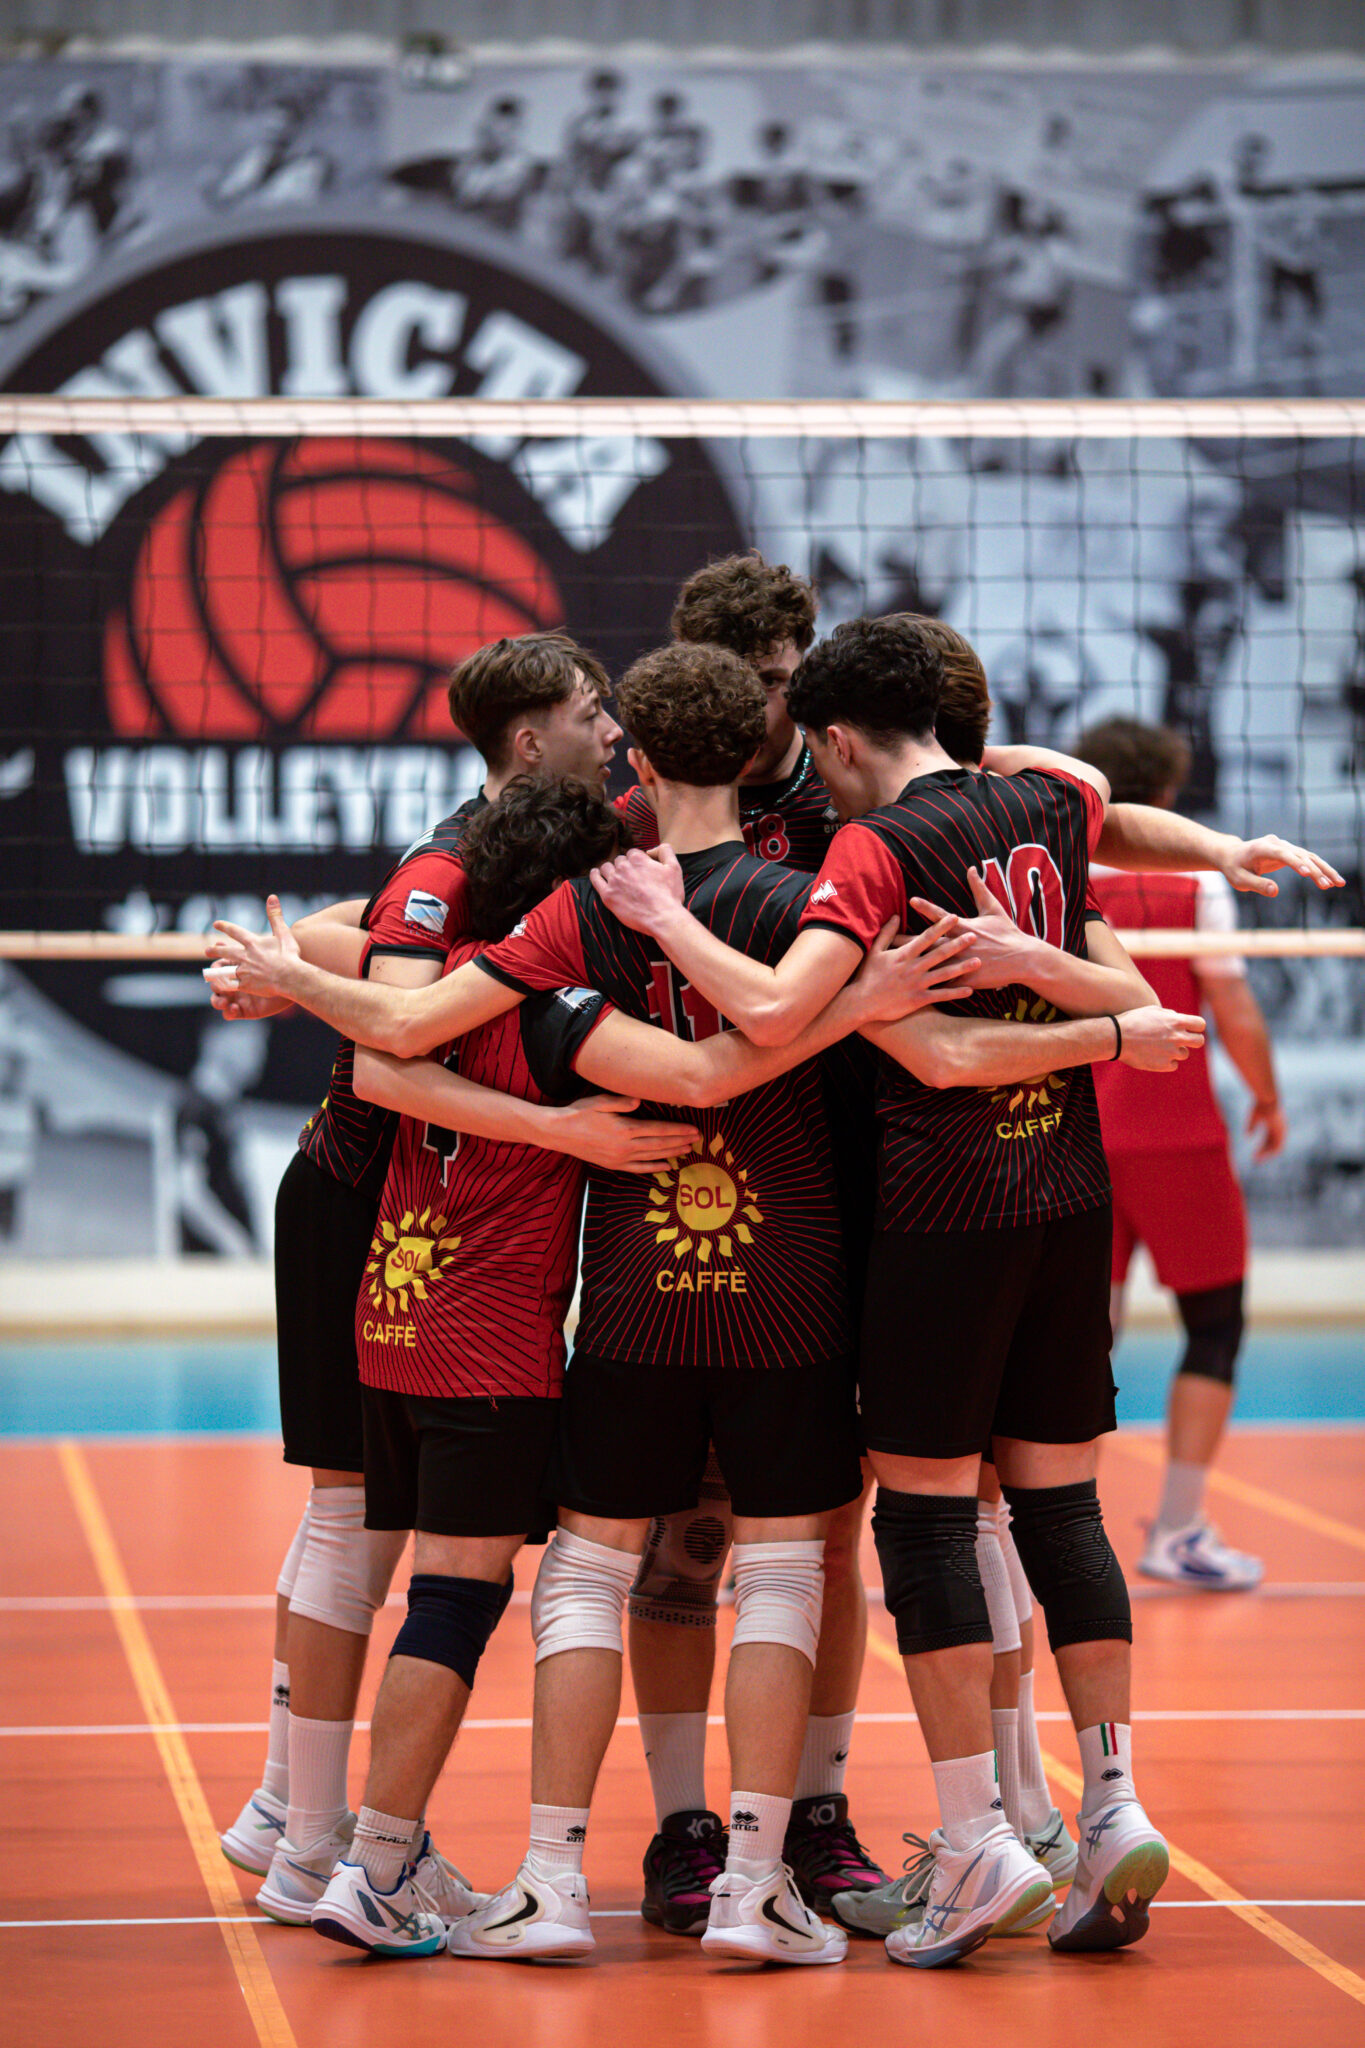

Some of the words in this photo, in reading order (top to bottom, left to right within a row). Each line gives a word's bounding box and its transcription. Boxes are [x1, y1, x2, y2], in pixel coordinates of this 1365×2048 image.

[679, 1183, 732, 1210] SOL
[391, 1248, 428, 1275] SOL
[656, 1265, 748, 1293] CAFFÈ
[363, 1320, 417, 1348] CAFFÈ
